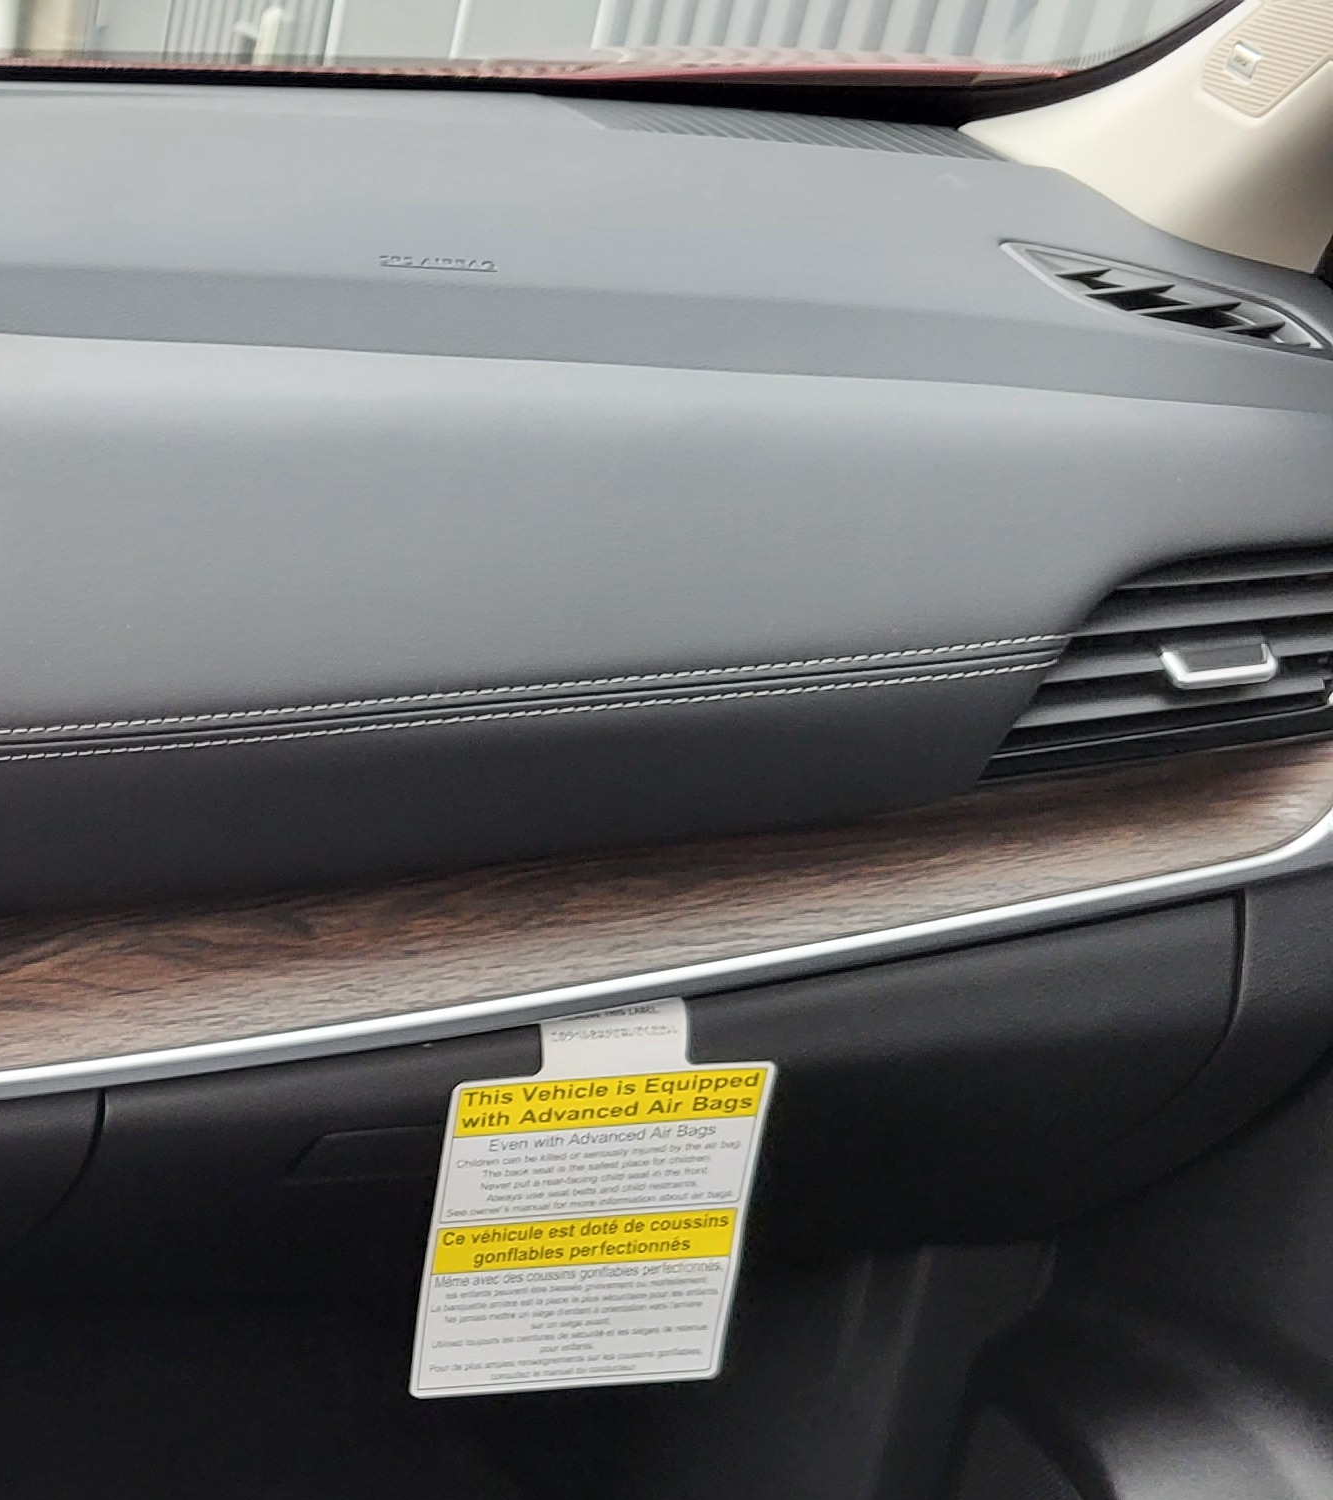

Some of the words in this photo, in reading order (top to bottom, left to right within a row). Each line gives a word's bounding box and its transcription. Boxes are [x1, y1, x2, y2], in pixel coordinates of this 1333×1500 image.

[464, 1091, 514, 1108] This
[523, 1080, 608, 1102] Vehicle
[616, 1079, 636, 1096] is
[644, 1071, 761, 1095] Equipped
[461, 1110, 510, 1129] with
[518, 1101, 639, 1125] Advanced
[647, 1098, 683, 1116] Air
[692, 1095, 753, 1113] Bags
[489, 1138, 529, 1153] Even
[533, 1134, 565, 1148] with
[567, 1128, 646, 1145] Advanced
[649, 1126, 673, 1139] Air
[676, 1124, 717, 1139] Bags
[456, 1158, 500, 1169] Children
[502, 1156, 522, 1165] can
[524, 1155, 538, 1163] be
[540, 1152, 567, 1162] killed
[569, 1152, 582, 1160] or
[669, 1144, 682, 1153] by
[685, 1142, 702, 1151] the
[482, 1169, 502, 1178] The
[569, 1163, 585, 1172] the
[588, 1161, 620, 1171] safest
[622, 1158, 650, 1169] place
[653, 1157, 666, 1166] for
[480, 1182, 511, 1191] Never
[513, 1180, 531, 1190] put
[542, 1175, 598, 1187] rear-facing
[664, 1168, 681, 1177] the
[447, 1209, 467, 1217] See
[554, 1200, 567, 1209] for
[486, 1193, 523, 1203] Always
[442, 1230, 465, 1247] Ce
[471, 1223, 544, 1244] véhicule
[548, 1223, 575, 1240] est
[580, 1216, 618, 1236] doté
[623, 1218, 645, 1233] de
[650, 1213, 730, 1232] coussins
[473, 1240, 565, 1268] gonflables
[568, 1236, 692, 1261] perfectionnés
[472, 1274, 500, 1286] avec
[503, 1272, 524, 1284] des
[526, 1270, 577, 1283] coussins
[579, 1266, 639, 1281] gonflables
